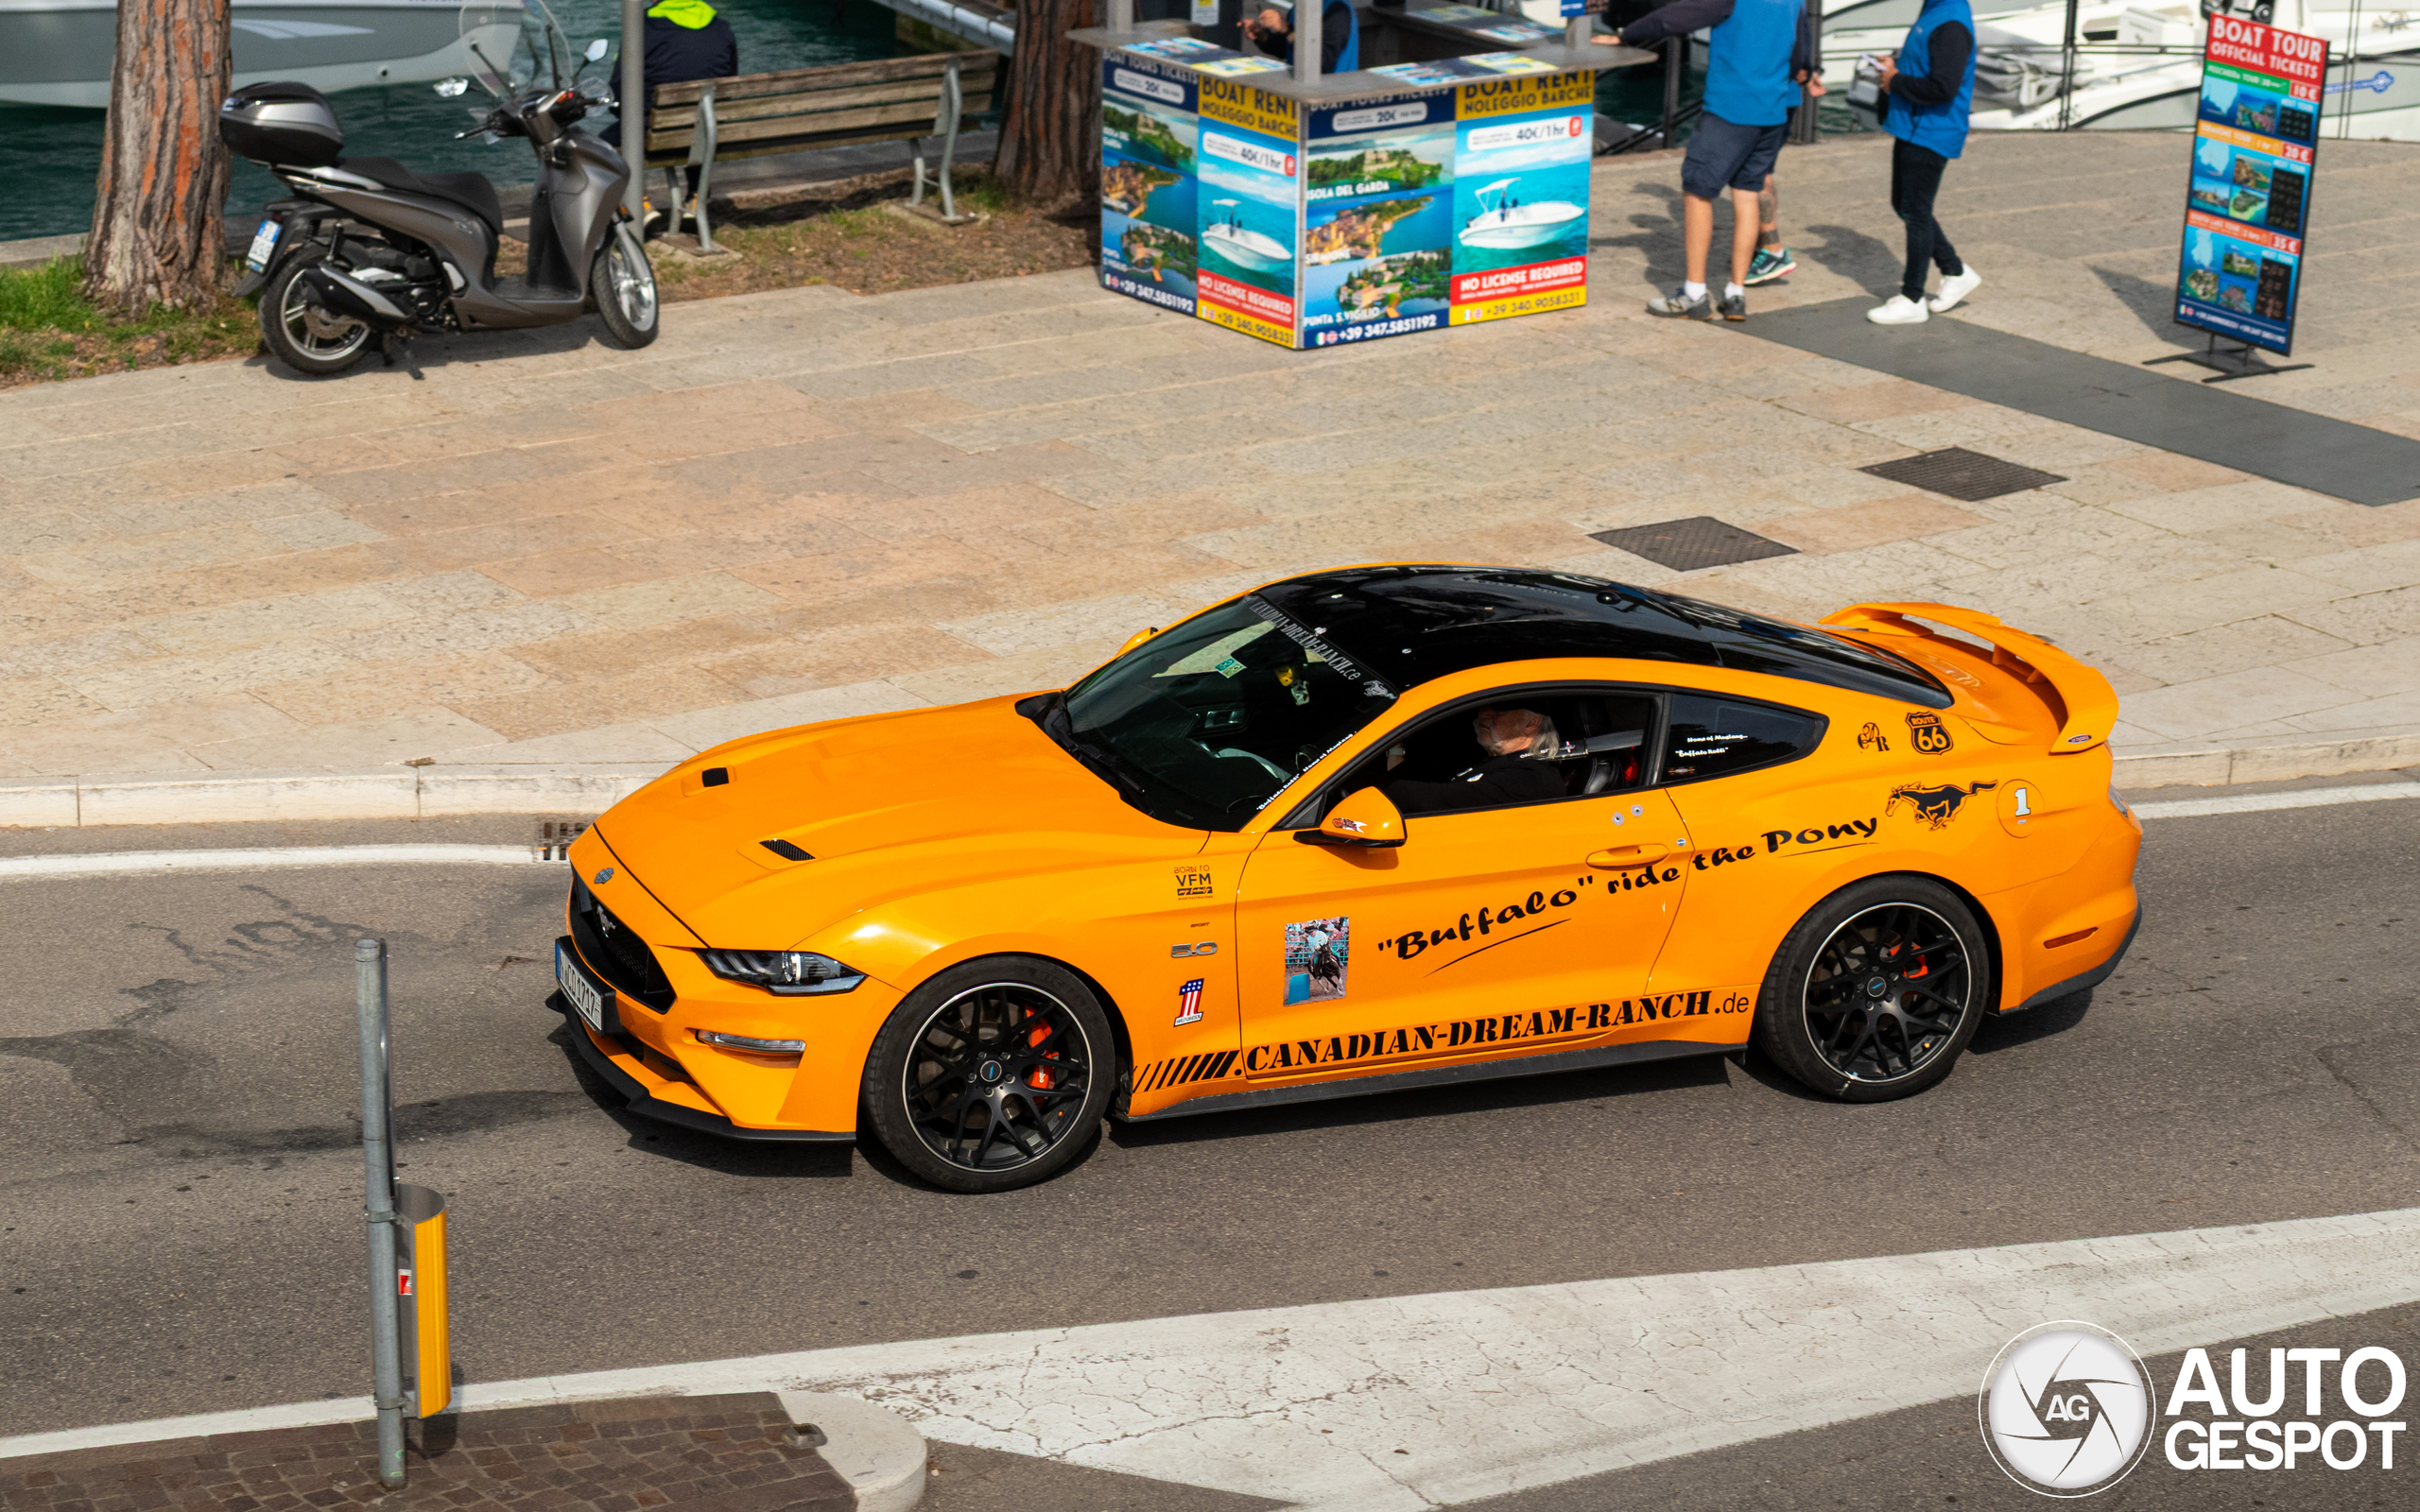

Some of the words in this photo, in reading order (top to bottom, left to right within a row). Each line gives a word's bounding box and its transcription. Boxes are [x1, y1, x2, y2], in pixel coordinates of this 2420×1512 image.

[2213, 18, 2265, 48] BOAT
[2272, 31, 2322, 62] TOUR
[2211, 41, 2266, 66] OFFICIAL
[2270, 55, 2318, 79] TICKETS
[1202, 77, 1245, 106] BOAT
[1254, 88, 1296, 120] RENT
[1465, 93, 1536, 114] NOLEGGIO
[1542, 85, 1590, 105] BARCHE
[2294, 85, 2307, 97] 10
[2308, 88, 2317, 100] €
[1336, 183, 1355, 197] DEL
[1356, 180, 1390, 195] GARDA
[1461, 277, 1479, 292] NO
[1481, 269, 1528, 289] LICENSE
[1529, 261, 1584, 282] REQUIRED
[1199, 275, 1213, 289] NO
[1214, 279, 1247, 301] LICENSE
[1248, 291, 1292, 316] REQUIRED
[1487, 304, 1507, 317] +39
[1340, 325, 1363, 341] +39
[1364, 314, 1437, 338] 347.5851192
[1910, 716, 1937, 726] ROUTE
[1917, 726, 1947, 751] 66
[2014, 787, 2031, 816] 1
[1174, 866, 1197, 874] BORN
[1176, 872, 1212, 887] VFM
[1377, 875, 1594, 960] "Buffalo"
[1607, 866, 1681, 894] ride
[1692, 846, 1756, 871] the
[1760, 817, 1877, 853] Pony
[1170, 940, 1218, 958] 5.0
